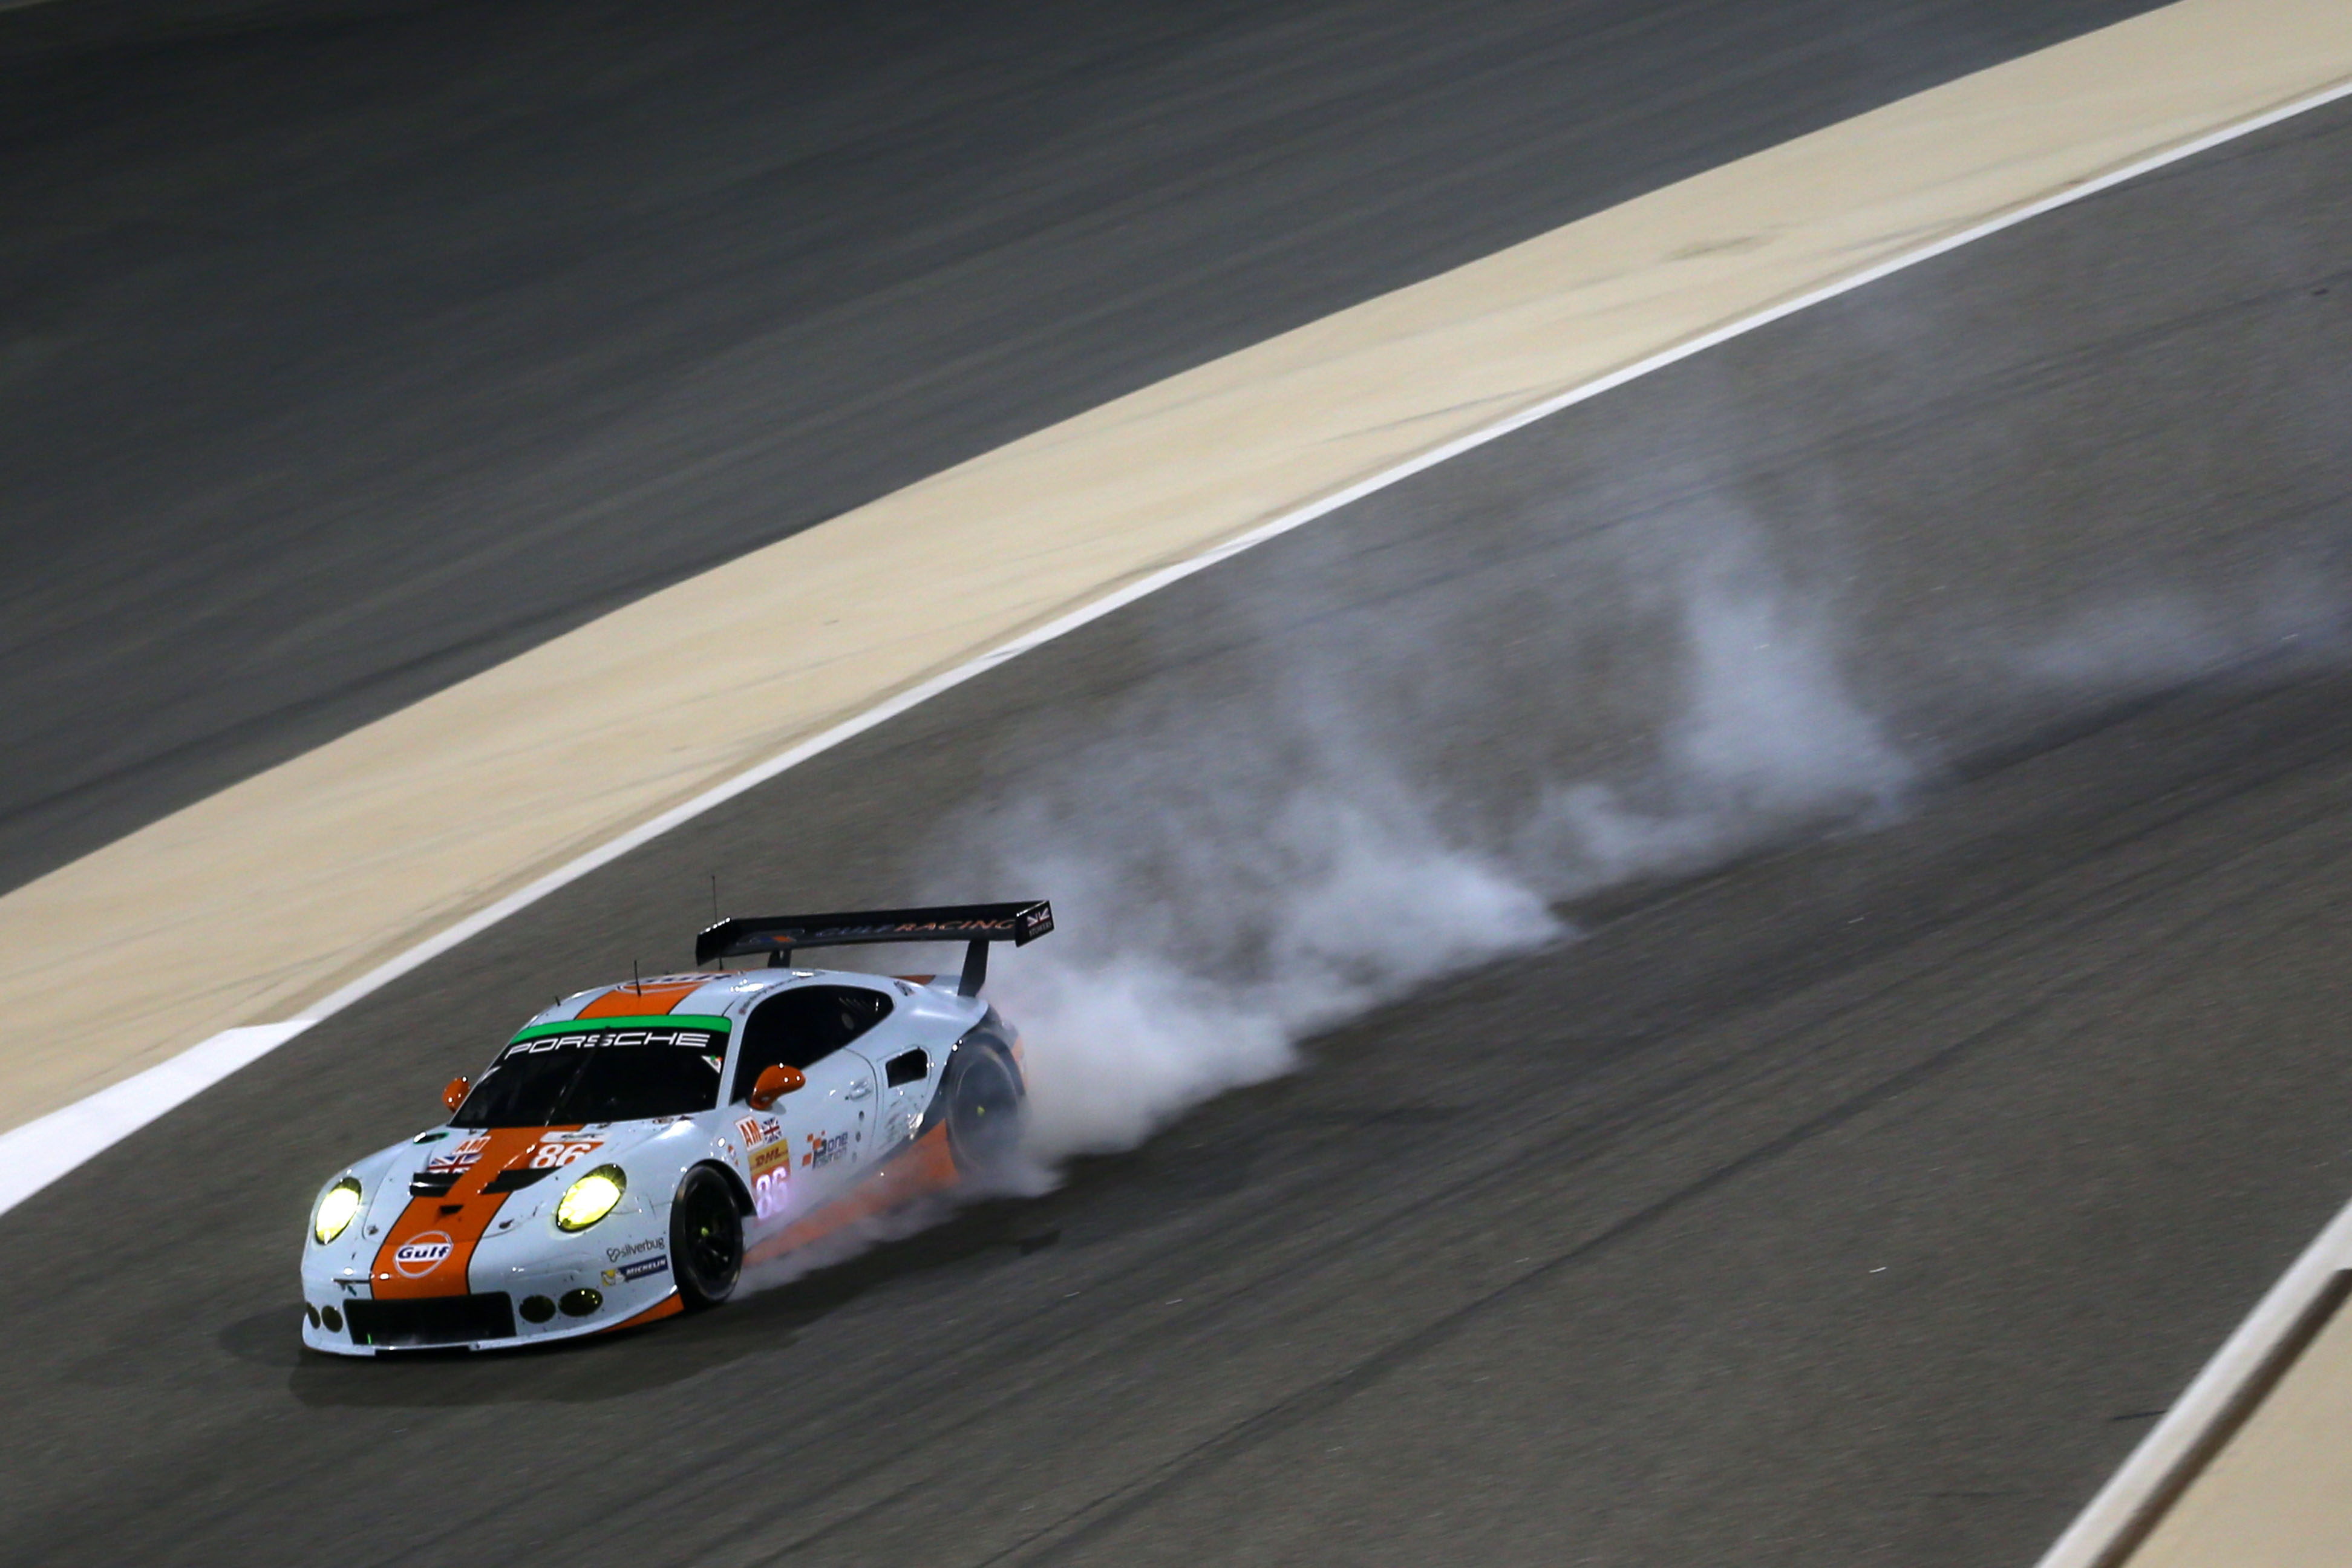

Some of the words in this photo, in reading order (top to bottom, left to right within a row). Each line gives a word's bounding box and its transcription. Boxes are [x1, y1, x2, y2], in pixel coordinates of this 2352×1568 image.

[894, 919, 1014, 932] RACING
[505, 1032, 710, 1060] PORSCHE
[740, 1119, 762, 1148] AM
[454, 1138, 488, 1152] AM
[529, 1143, 591, 1169] 86
[756, 1148, 780, 1166] DHL
[756, 1166, 787, 1219] 86
[398, 1246, 449, 1258] Gulf
[626, 1259, 666, 1275] MICHELIN
